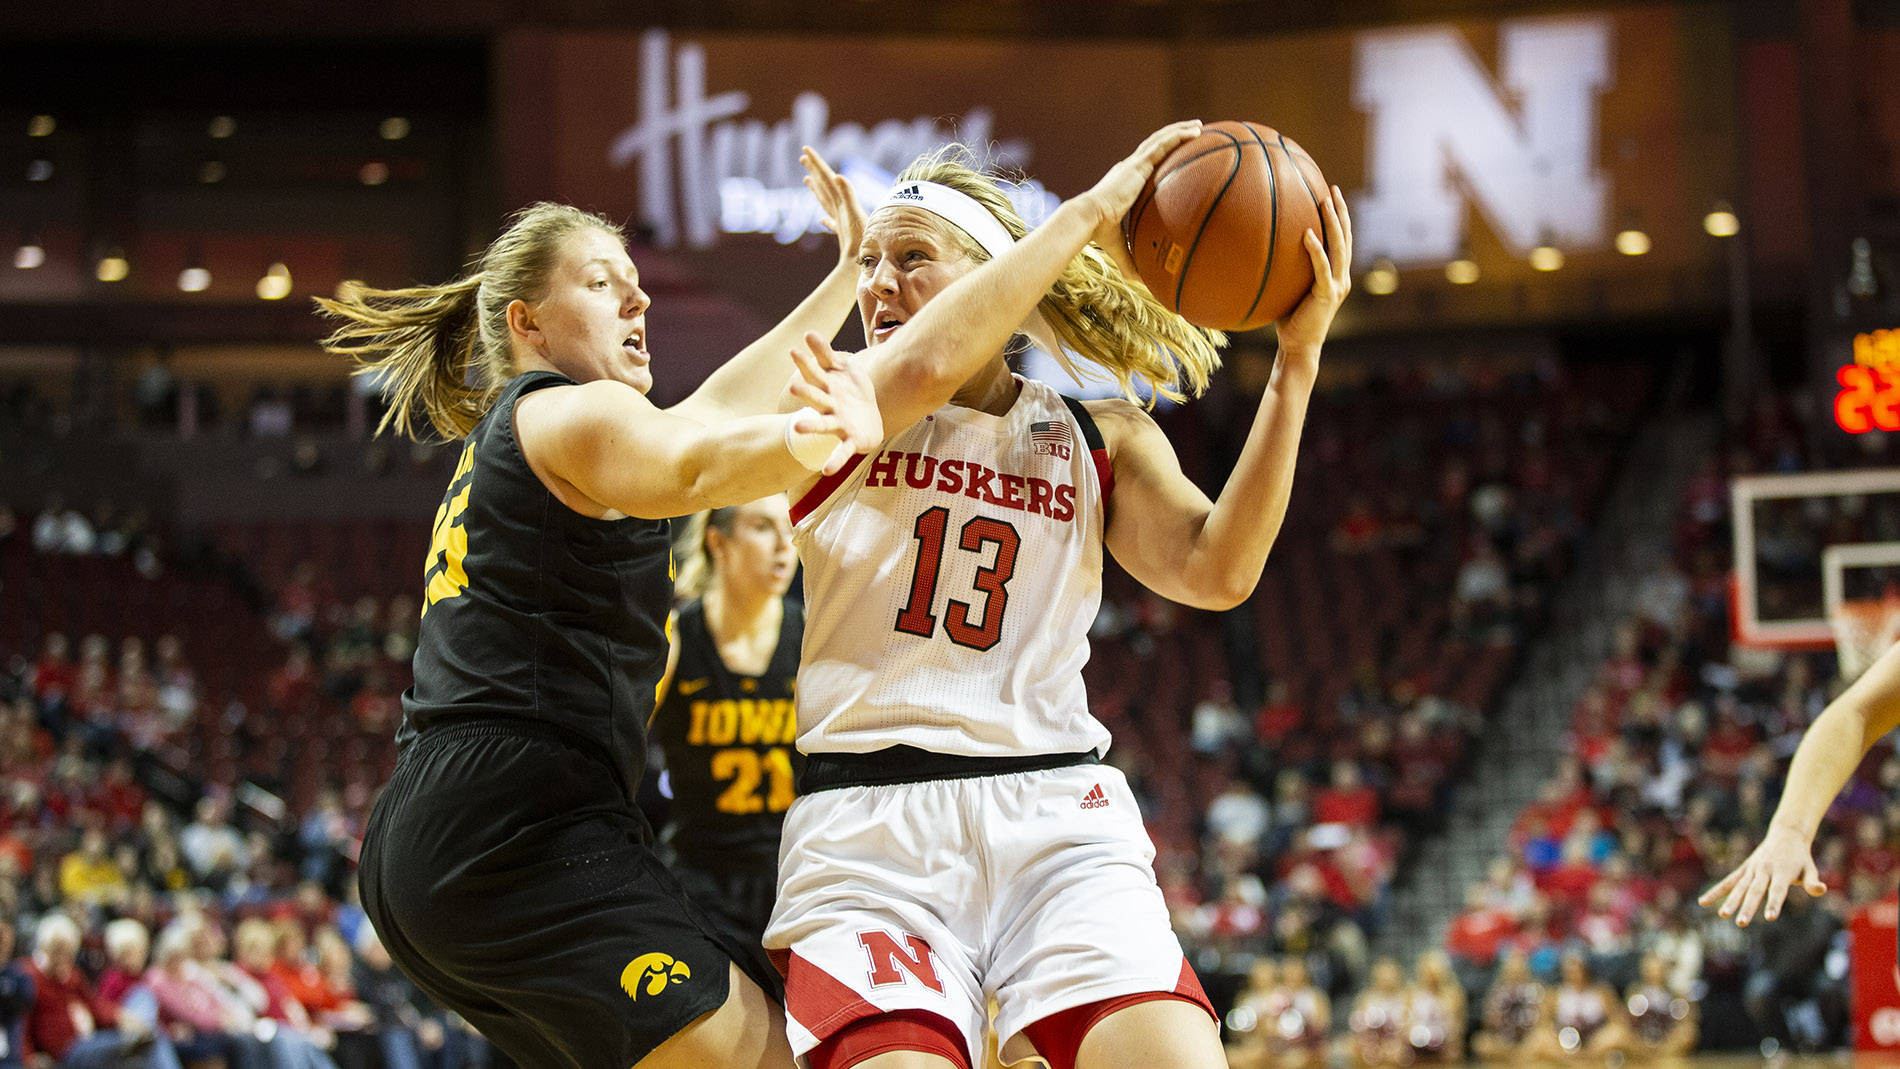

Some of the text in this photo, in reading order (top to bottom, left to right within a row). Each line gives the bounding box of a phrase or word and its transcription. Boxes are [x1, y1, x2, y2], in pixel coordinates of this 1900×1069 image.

[1355, 17, 1613, 263] N
[865, 450, 1077, 522] HUSKERS
[894, 505, 1021, 652] 13
[711, 748, 798, 815] 21
[1080, 798, 1110, 810] adidas
[856, 928, 947, 999] N
